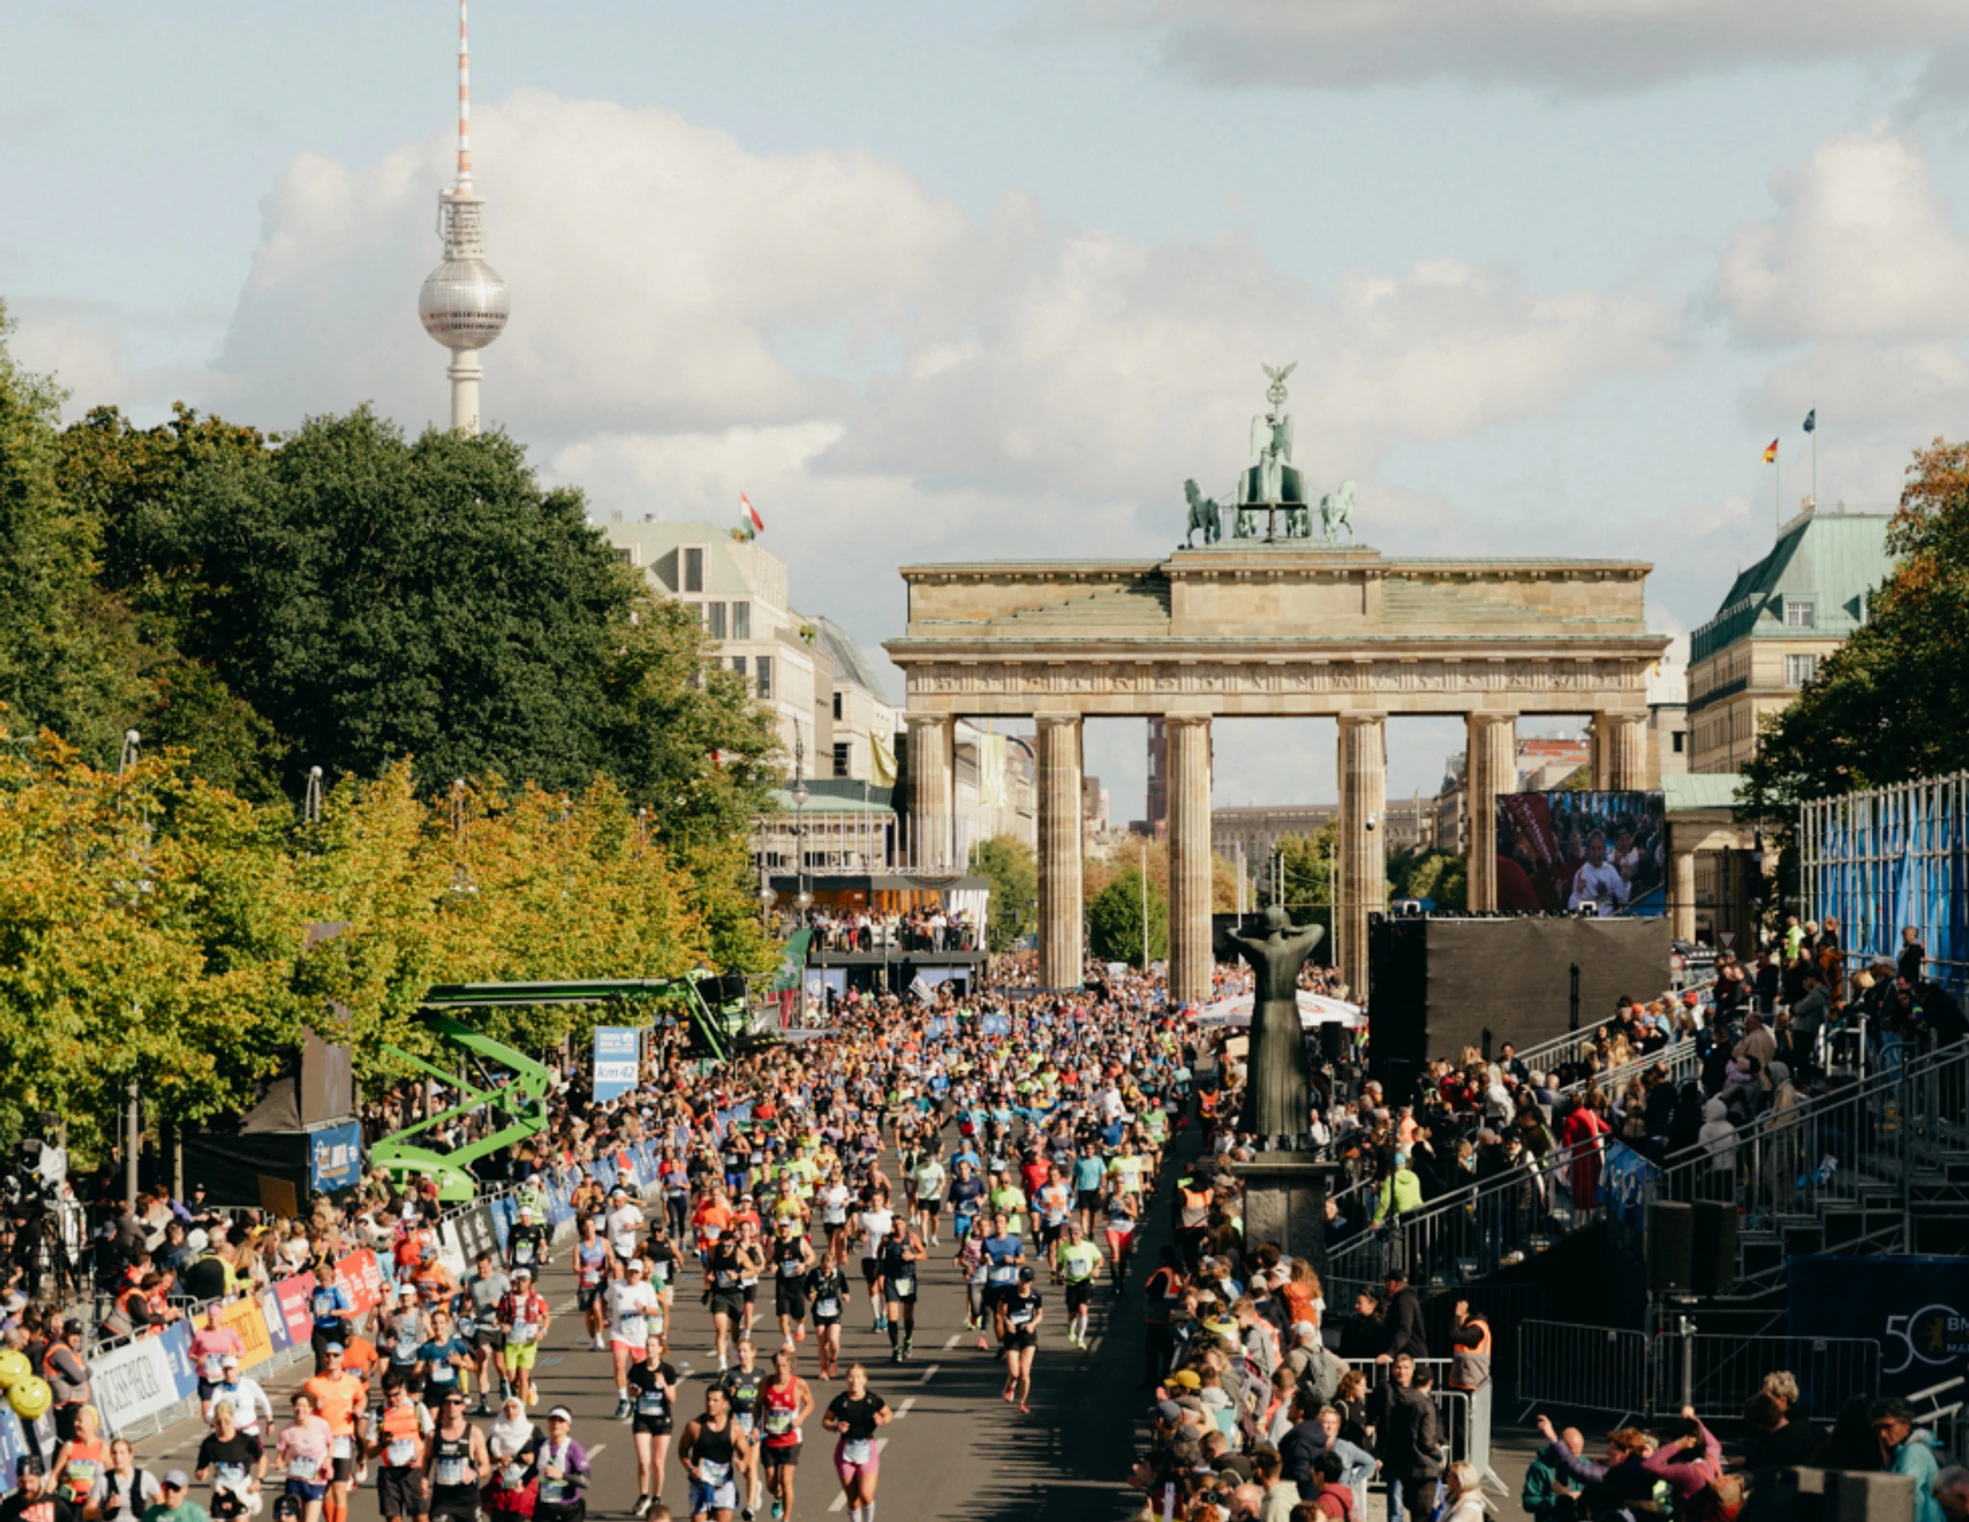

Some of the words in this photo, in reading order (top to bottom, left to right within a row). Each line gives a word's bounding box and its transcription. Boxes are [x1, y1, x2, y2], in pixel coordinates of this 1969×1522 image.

[597, 1065, 618, 1078] km
[620, 1066, 635, 1078] 42
[1882, 1303, 1960, 1374] 50
